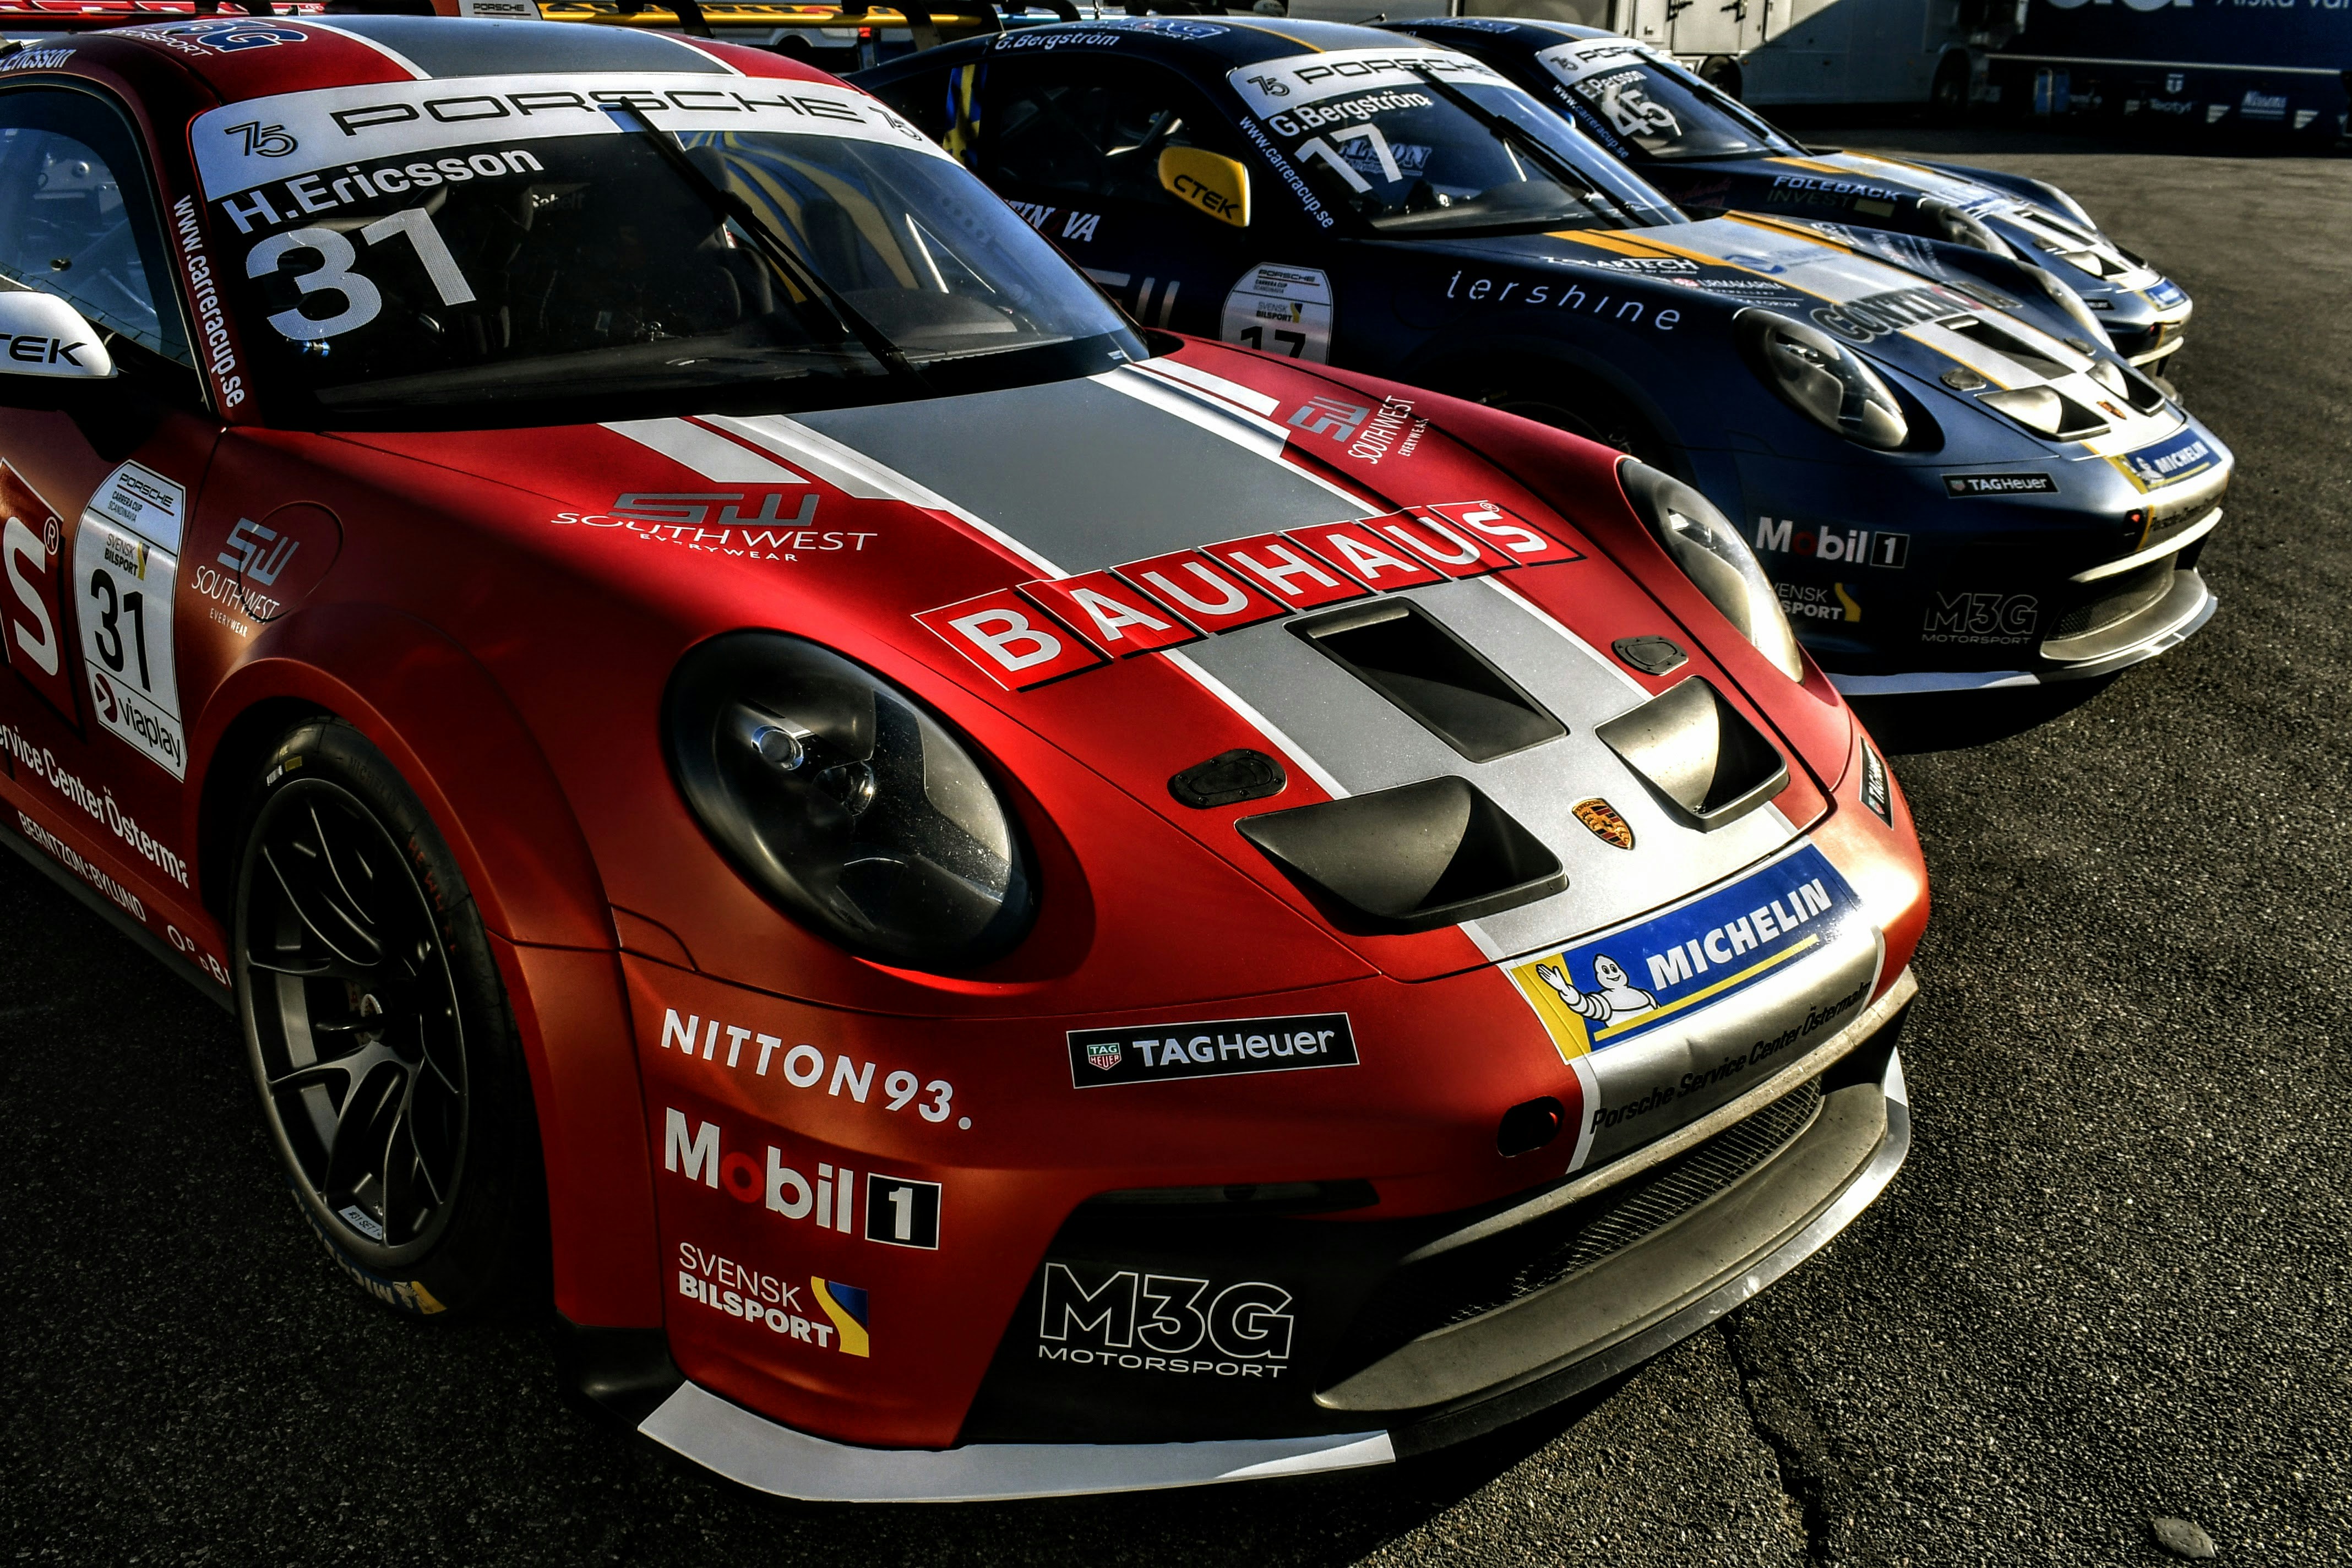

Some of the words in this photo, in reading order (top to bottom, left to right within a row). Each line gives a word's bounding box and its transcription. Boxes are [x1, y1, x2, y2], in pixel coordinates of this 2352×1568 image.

[0, 46, 77, 72] .Ericsson
[995, 32, 1120, 51] G.Bergström
[1246, 75, 1291, 97] 75
[224, 121, 298, 157] 75
[329, 90, 867, 137] PORSCHE
[1268, 90, 1434, 138] G.Bergström
[1237, 115, 1335, 229] www.carreracup.se
[1294, 122, 1403, 193] 17
[221, 149, 545, 235] H.Ericsson
[1173, 173, 1241, 220] CTEK
[246, 207, 477, 342] 31
[1258, 269, 1316, 282] PORSCHE
[173, 193, 246, 409] www.carreracup.se
[1256, 310, 1293, 322] BILSPORT
[1240, 326, 1306, 359] 17
[112, 490, 133, 509] CARRERA
[132, 501, 143, 513] CUP
[118, 472, 175, 508] PORSCHE
[104, 547, 139, 576] BILSPORT
[106, 532, 137, 559] SVENSK
[1755, 515, 1869, 564] Mobil
[1883, 536, 1898, 564] 1
[90, 568, 152, 694] 31
[1923, 590, 2039, 635] M3G
[1921, 634, 2033, 645] MOTORSPORT
[117, 697, 181, 767] viaplay
[43, 748, 105, 825] Center
[1645, 876, 1833, 992] MICHELIN
[1089, 1045, 1118, 1054] TAG
[1090, 1054, 1121, 1069] HEUER
[1590, 1082, 1675, 1135] Porsche
[1677, 1054, 1747, 1098] Service
[1749, 1023, 1803, 1065] Center
[1801, 981, 1872, 1037] Östermalm
[665, 1106, 854, 1235] Mobil
[888, 1186, 913, 1240] 1
[679, 1242, 803, 1313] SVENSK
[678, 1270, 834, 1348] BILSPORT
[1039, 1262, 1294, 1360] M3G
[1038, 1344, 1288, 1378] MOTORSPORT
